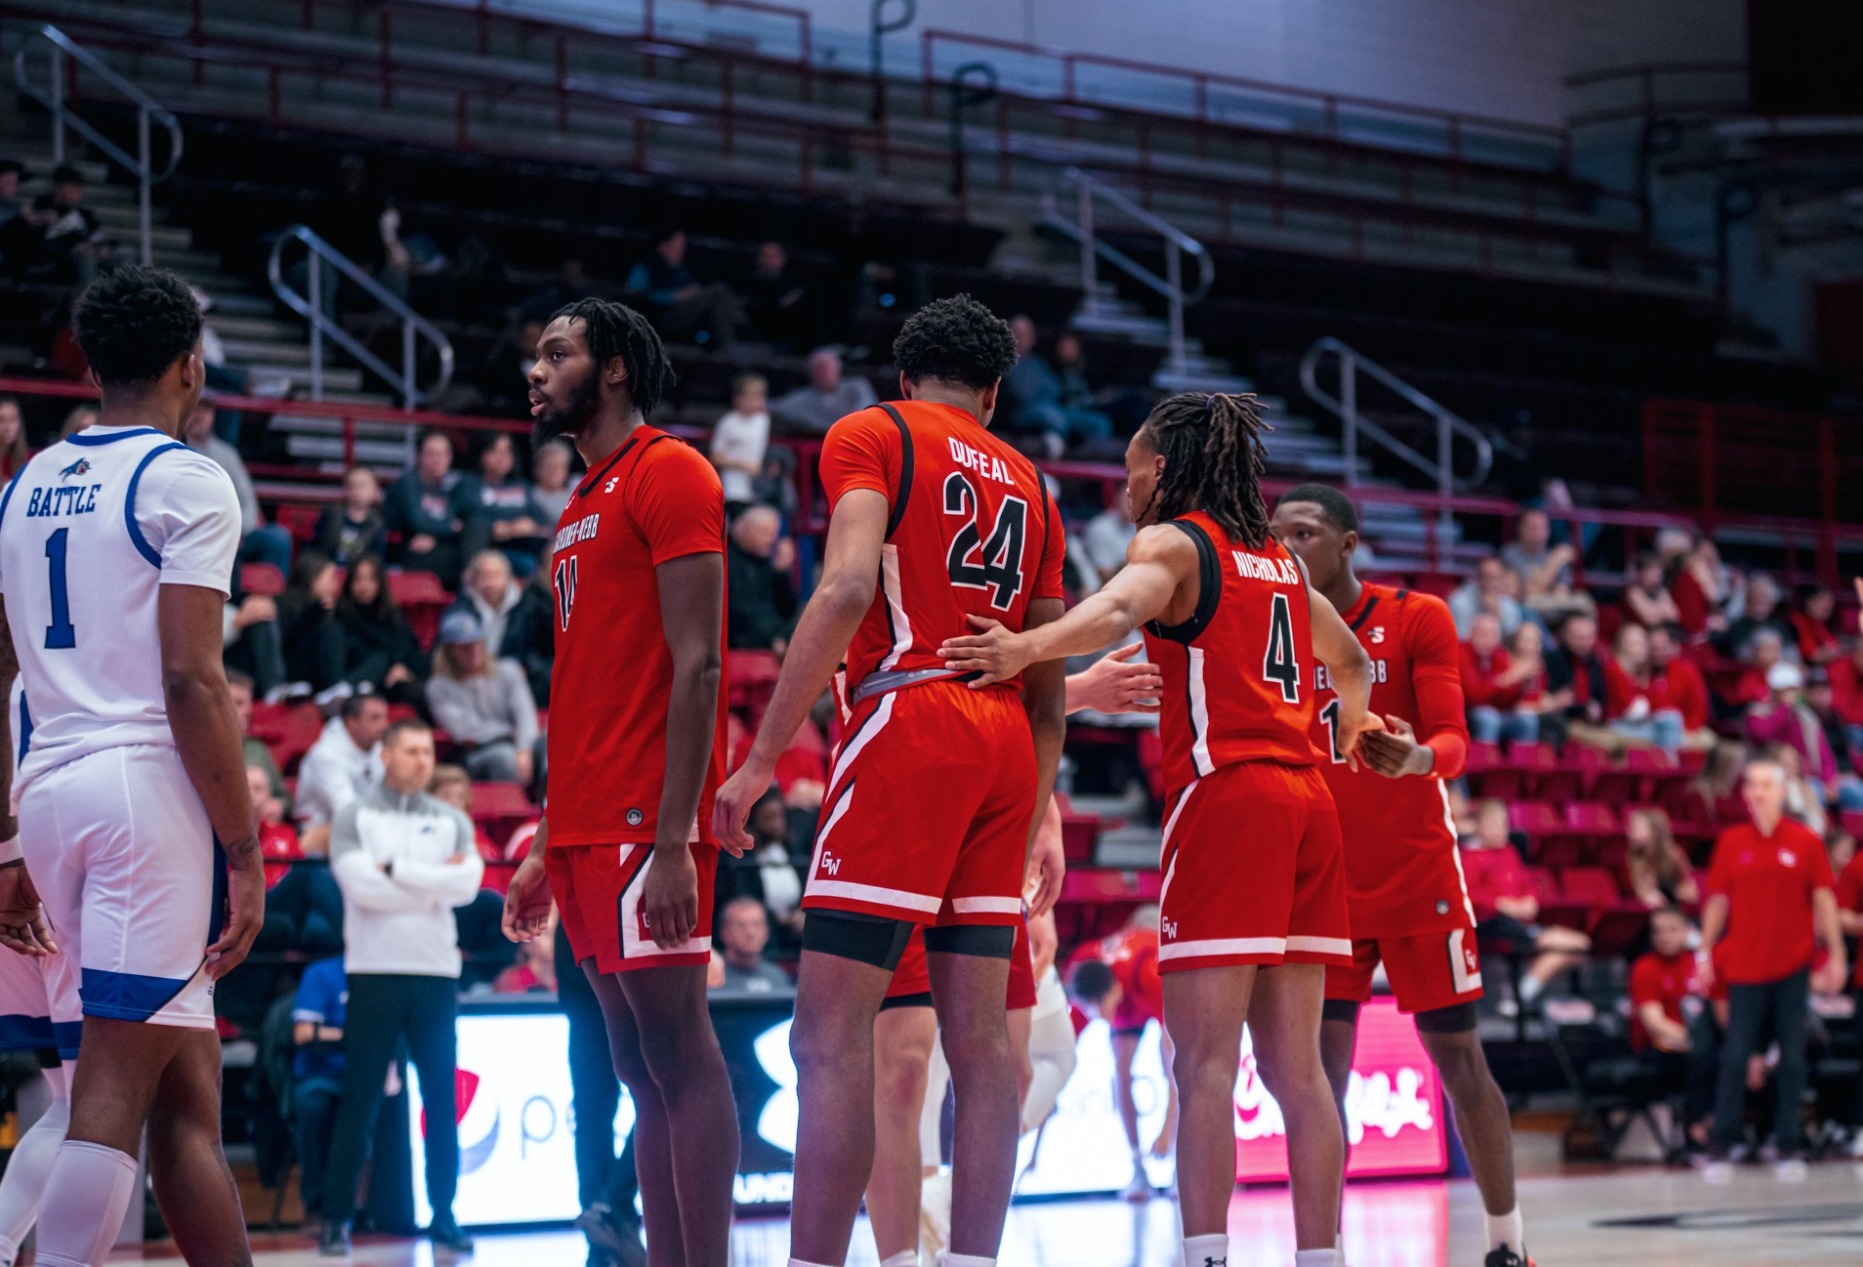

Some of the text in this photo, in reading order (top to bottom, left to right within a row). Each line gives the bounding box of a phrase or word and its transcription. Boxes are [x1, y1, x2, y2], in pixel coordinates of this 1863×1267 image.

[948, 436, 1015, 486] DUFEAL
[26, 484, 102, 518] BATTLE
[943, 471, 1028, 611] 24
[1231, 550, 1299, 586] NICHOLAS
[44, 527, 77, 650] 1
[1263, 592, 1301, 704] 4
[821, 851, 842, 876] GW
[1162, 916, 1178, 940] GW
[733, 1172, 794, 1204] UND
